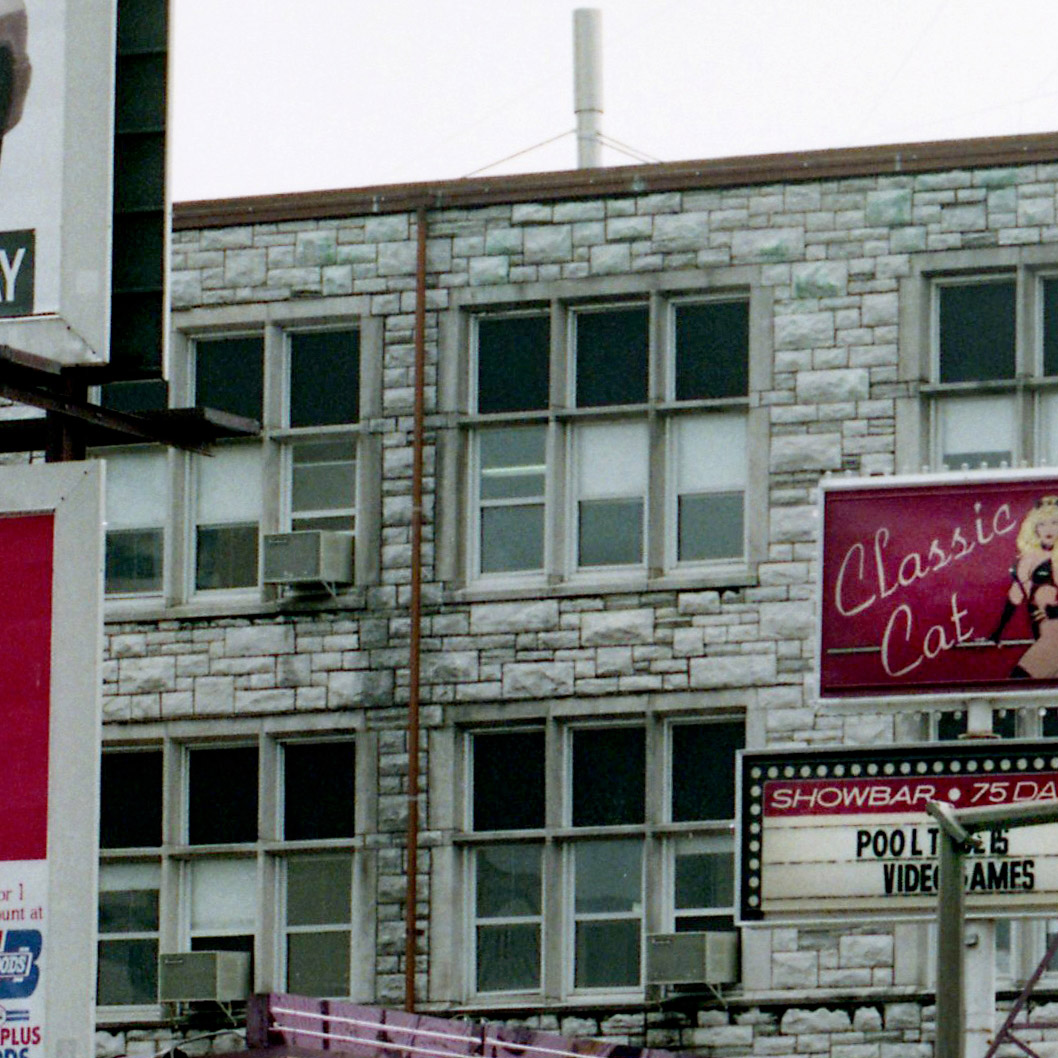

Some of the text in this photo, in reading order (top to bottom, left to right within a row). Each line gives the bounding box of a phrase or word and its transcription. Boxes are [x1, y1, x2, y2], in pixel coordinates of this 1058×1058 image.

[881, 593, 974, 677] Cat
[770, 785, 935, 809] SHOWBAR
[970, 781, 1010, 803] 75
[856, 828, 923, 857] POOL
[883, 859, 1035, 894] VIDE AMES
[0, 1025, 41, 1046] PLUS
